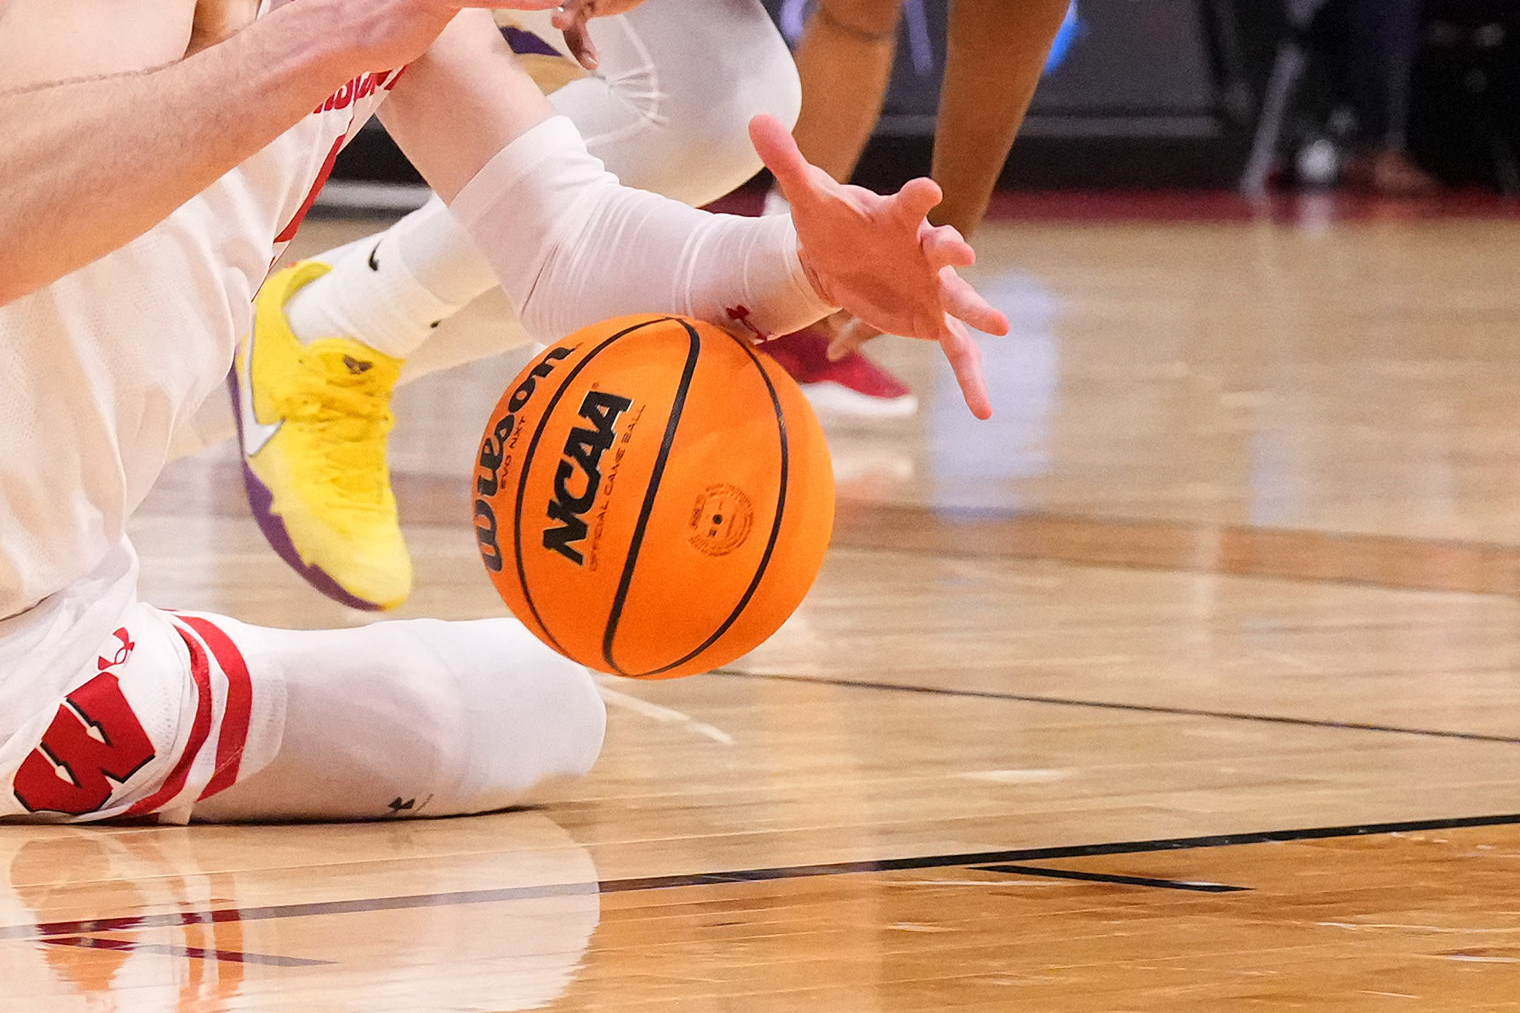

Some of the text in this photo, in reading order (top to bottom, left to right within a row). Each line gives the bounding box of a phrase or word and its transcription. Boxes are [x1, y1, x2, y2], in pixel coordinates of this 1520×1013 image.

[474, 346, 576, 573] Wilson
[509, 416, 526, 450] NXT
[543, 389, 634, 566] NCAA
[13, 672, 156, 815] W
